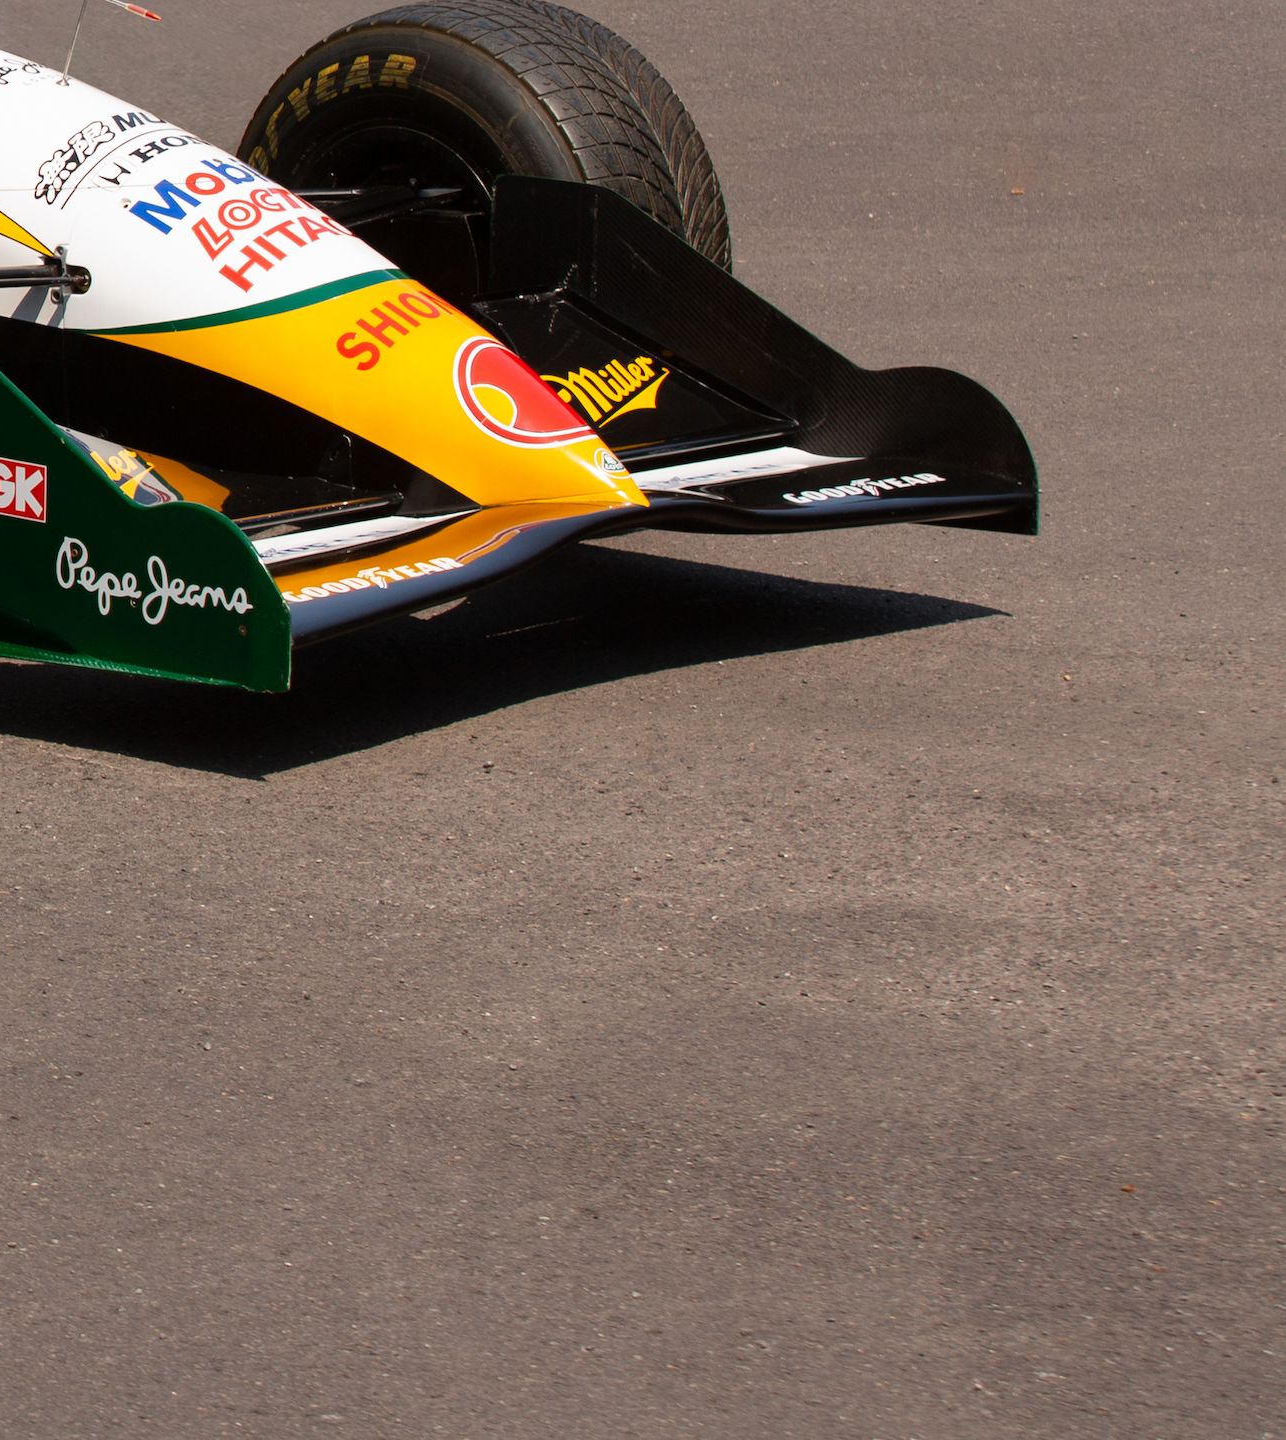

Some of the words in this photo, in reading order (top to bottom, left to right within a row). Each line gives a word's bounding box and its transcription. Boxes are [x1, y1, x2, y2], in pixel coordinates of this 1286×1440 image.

[538, 356, 654, 424] Miller
[782, 472, 946, 504] GOODYEAR
[56, 536, 142, 616] Pepe
[142, 556, 254, 625] Jeans
[282, 557, 465, 603] GOODYEAR
